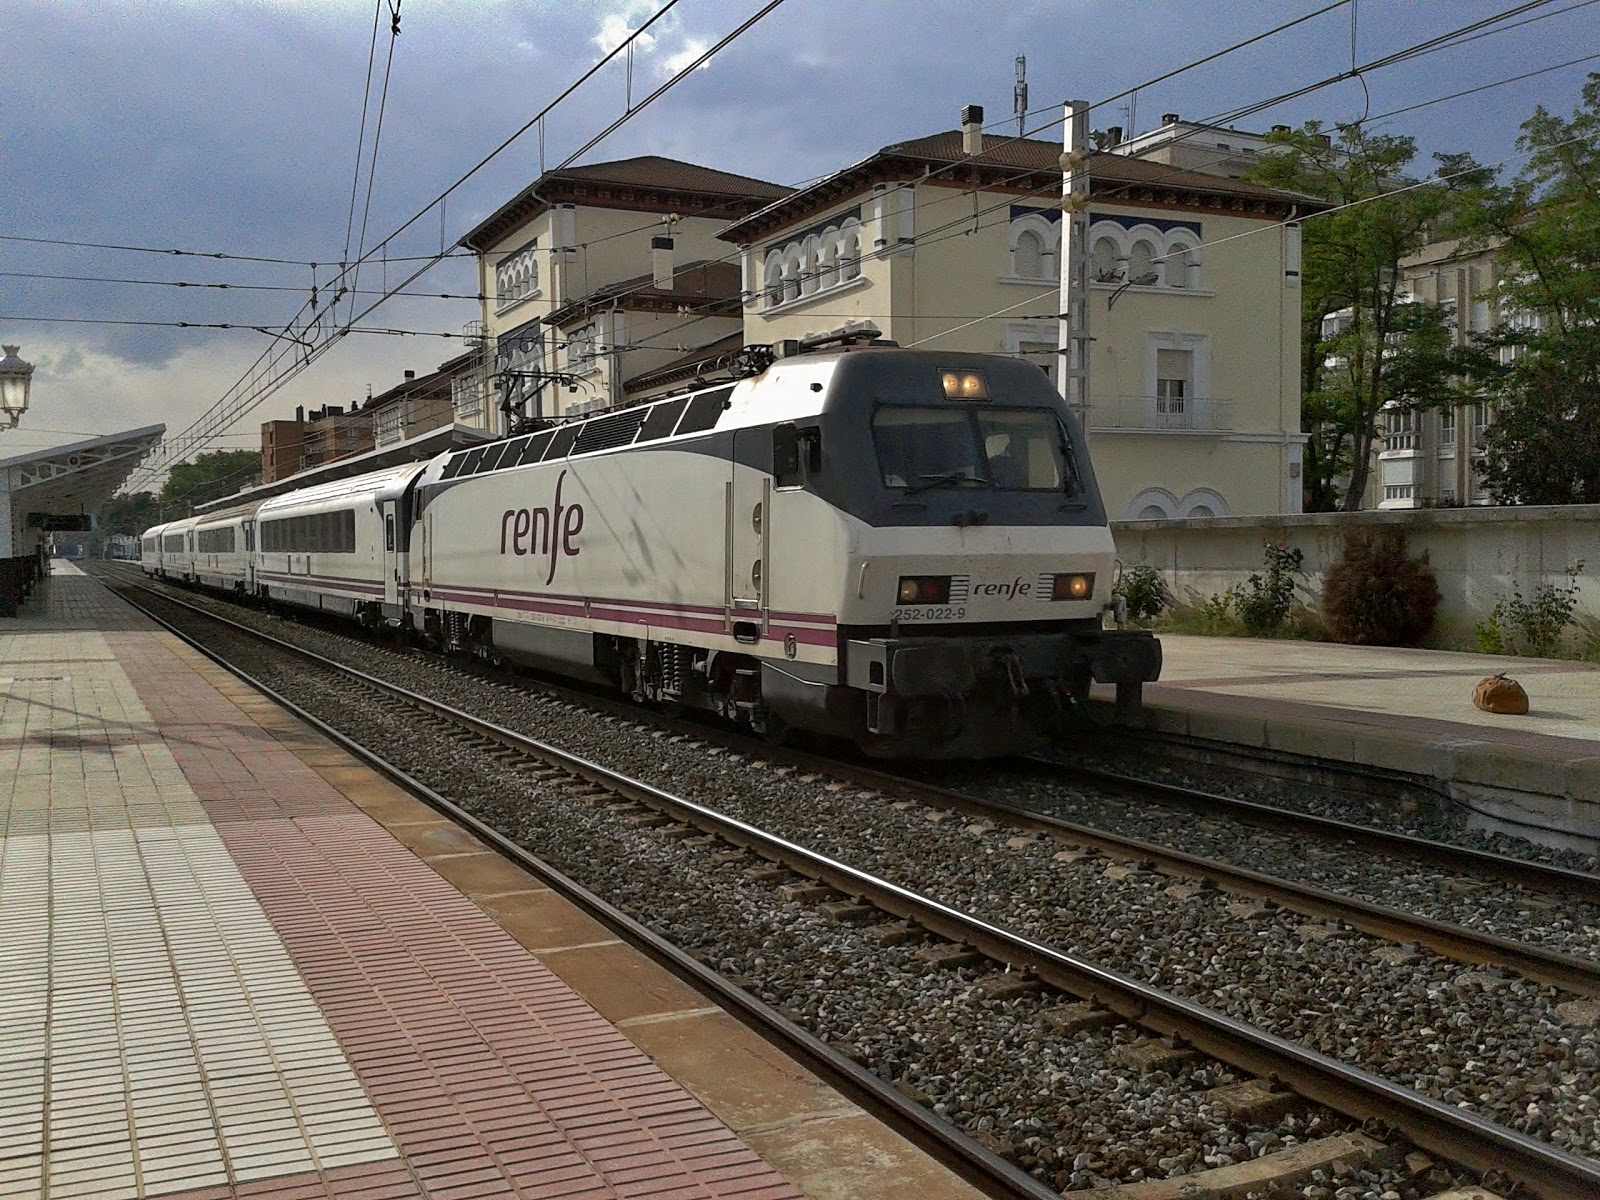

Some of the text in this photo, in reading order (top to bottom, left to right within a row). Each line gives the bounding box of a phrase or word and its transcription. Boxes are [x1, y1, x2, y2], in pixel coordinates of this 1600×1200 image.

[500, 469, 584, 586] renfe
[973, 576, 1032, 601] renfe
[895, 608, 966, 621] 252-022-9
